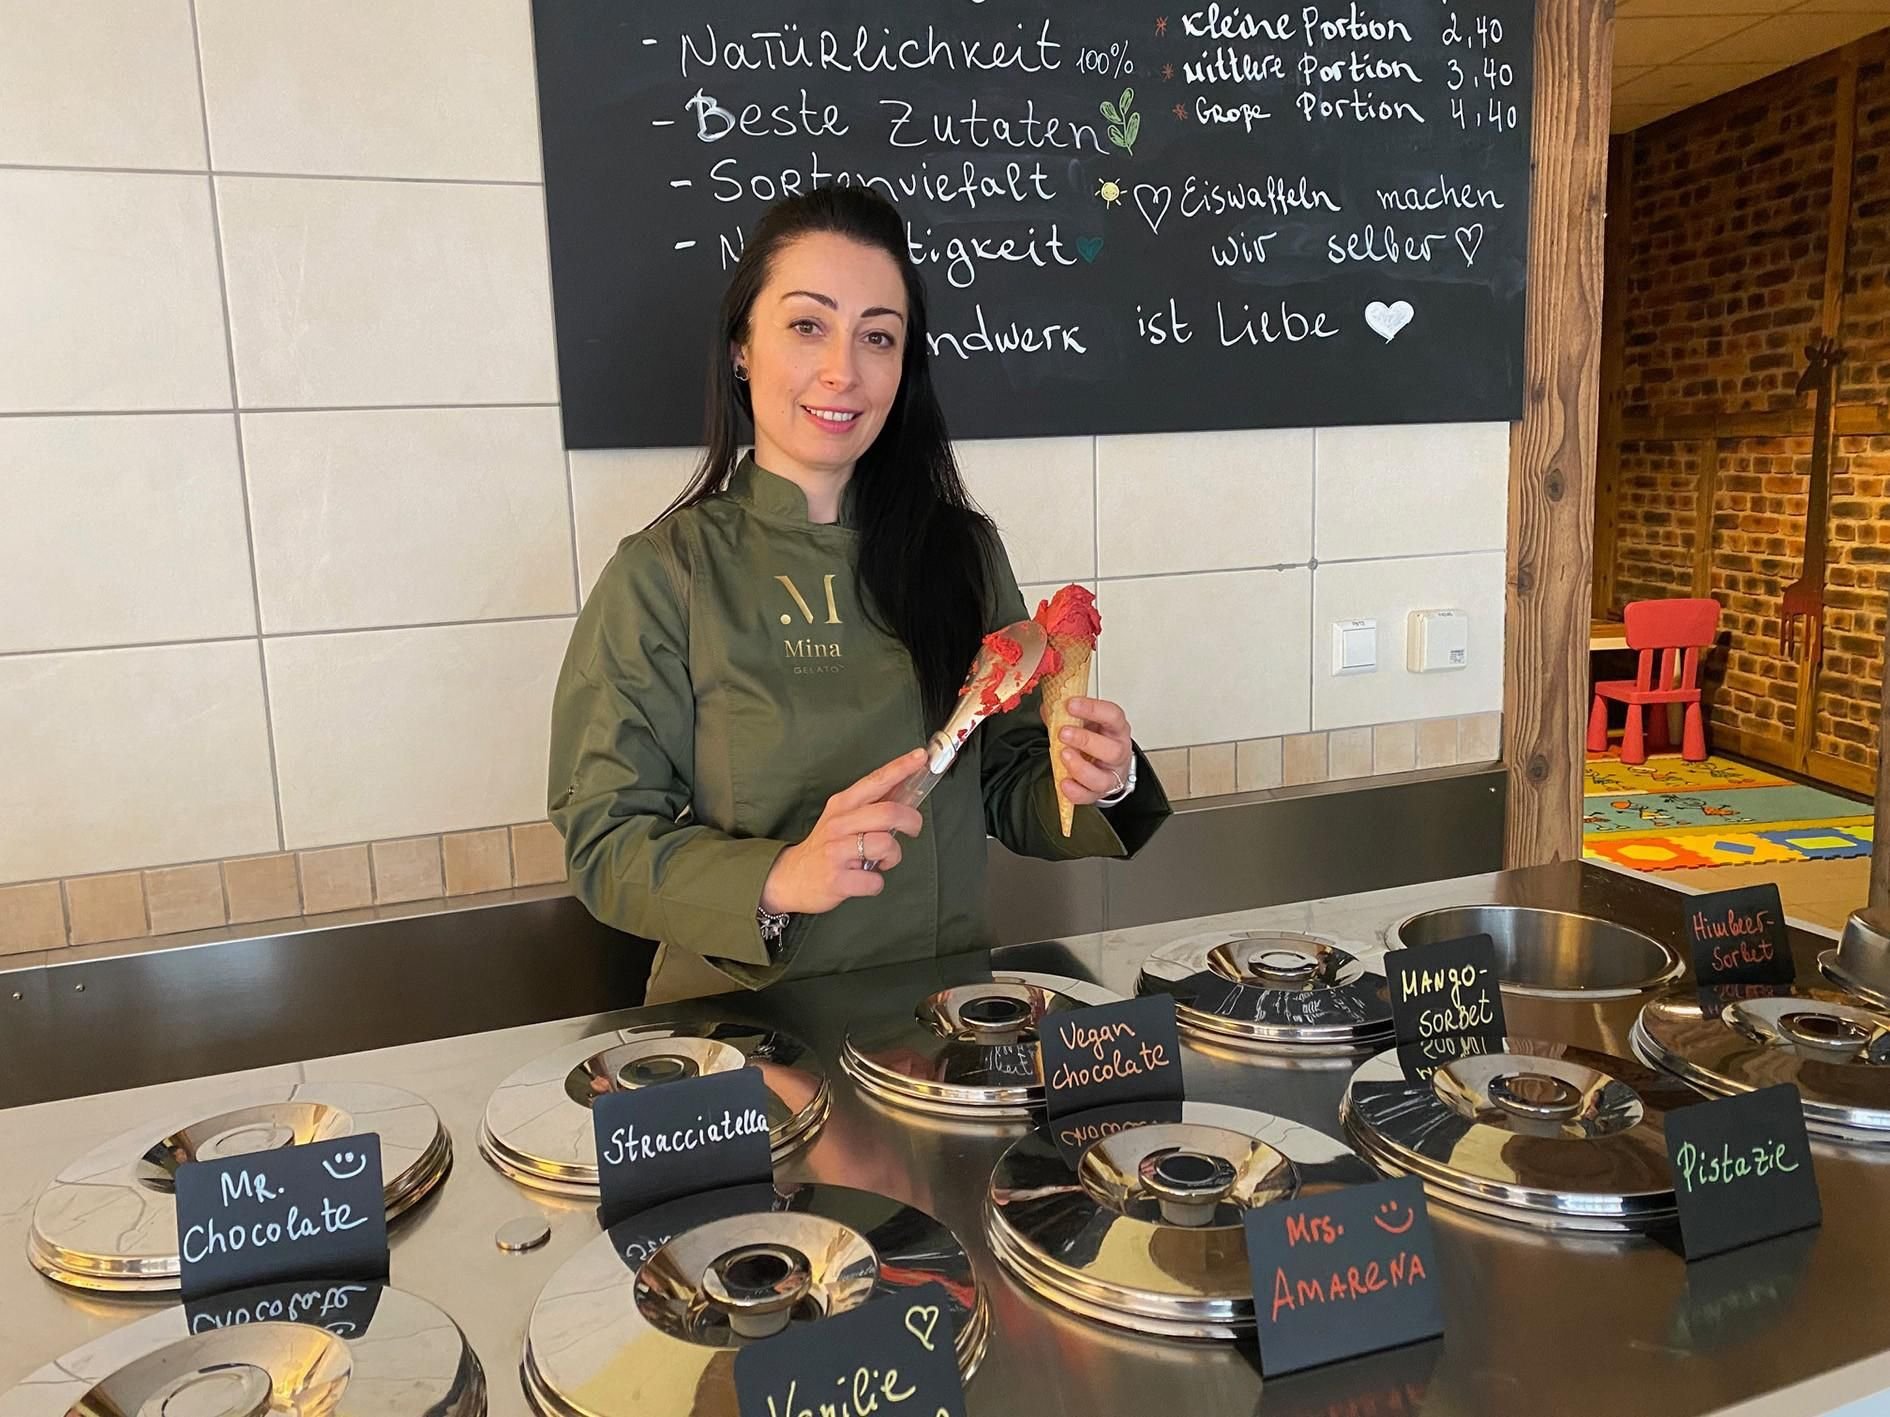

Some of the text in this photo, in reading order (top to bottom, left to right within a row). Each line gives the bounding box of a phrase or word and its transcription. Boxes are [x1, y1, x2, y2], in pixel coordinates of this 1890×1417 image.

[1303, 2, 1411, 47] Portion
[1443, 13, 1503, 48] 2,40
[1076, 40, 1134, 79] 100%
[1298, 51, 1422, 86] Portion
[1447, 57, 1513, 91] 3,40
[685, 88, 1109, 155] Beste Zutaten
[1296, 89, 1424, 123] Portion
[1451, 98, 1517, 132] 4,40
[1180, 175, 1504, 217] Eiswaffeln machen
[1212, 225, 1446, 267] wir selber
[1137, 299, 1192, 345] ist
[1218, 301, 1338, 347] Liebe
[784, 638, 842, 658] Mina
[793, 664, 839, 675] GELATO
[1712, 940, 1774, 971] Sorbet
[1059, 1021, 1136, 1061] Vegan
[1676, 1139, 1800, 1192] Pistazie
[183, 1198, 368, 1263] Chocolate
[1286, 1212, 1345, 1247] Mrs.
